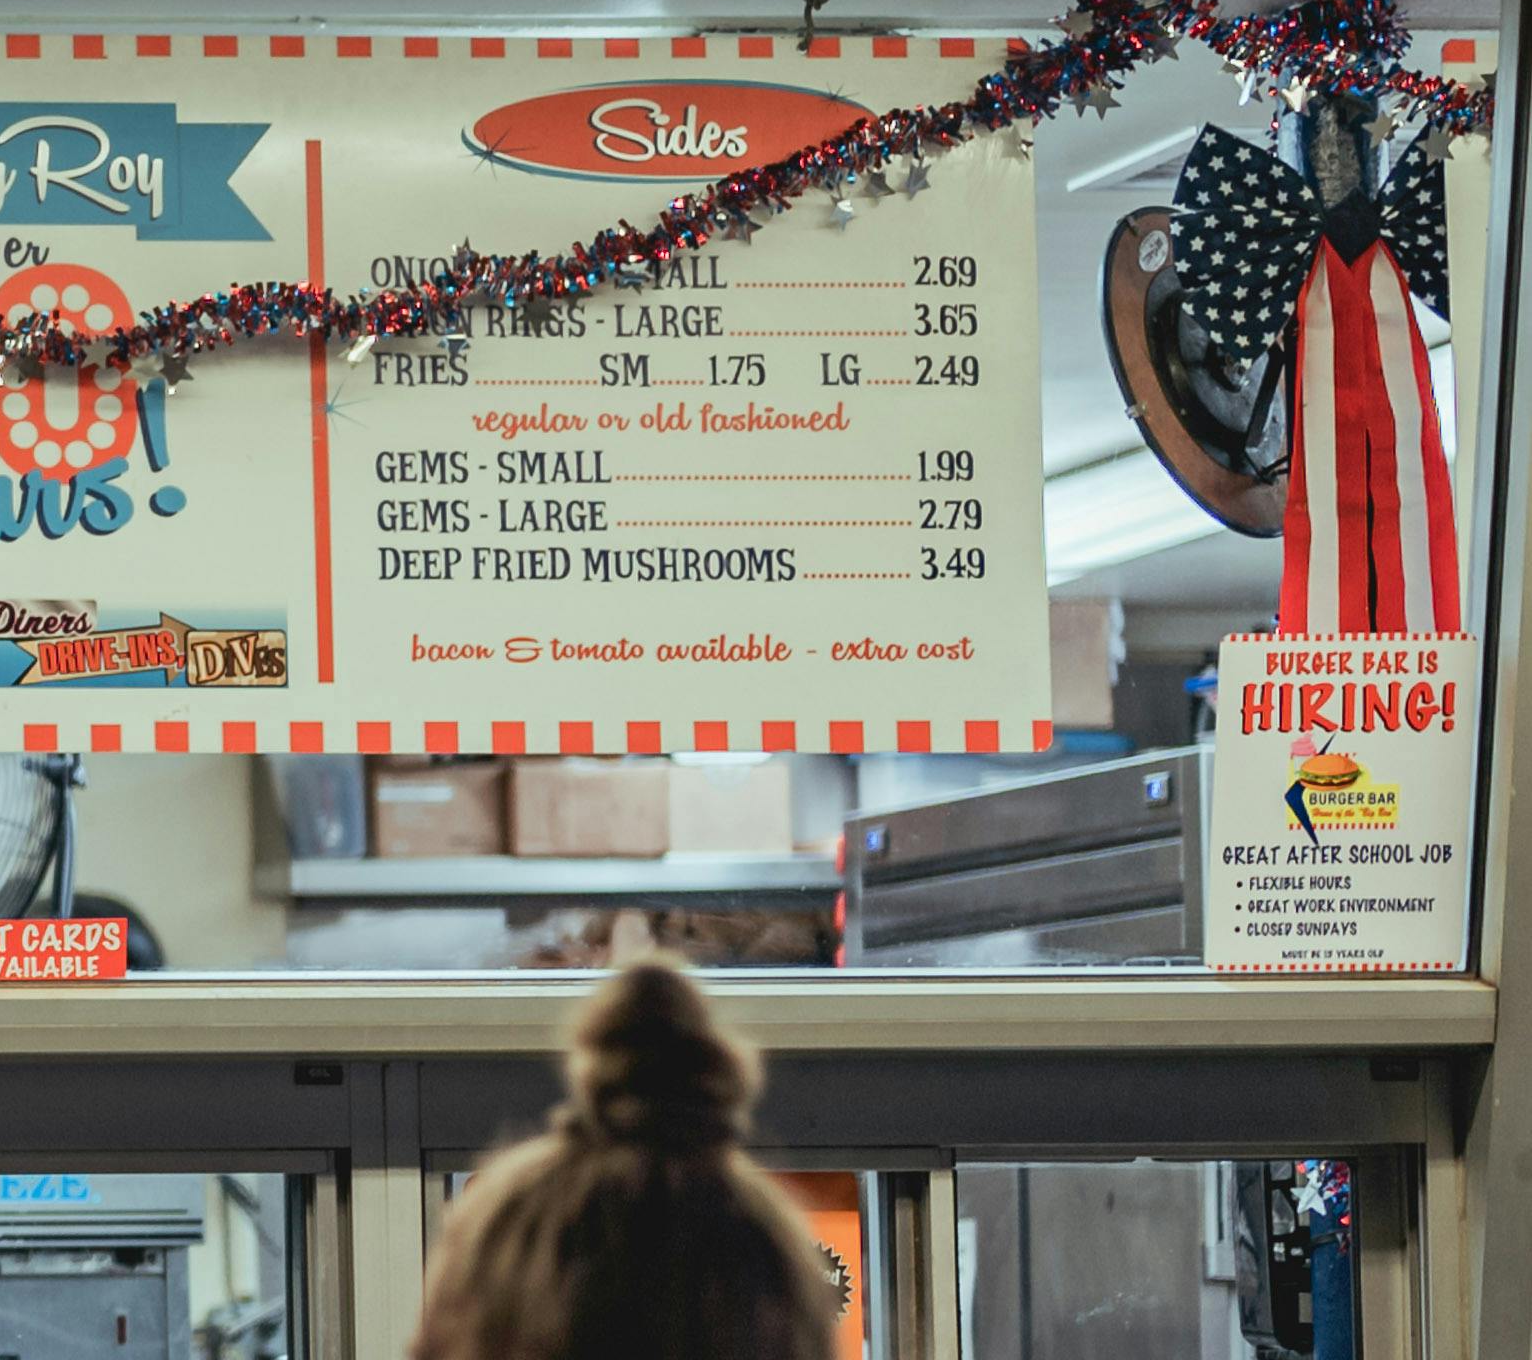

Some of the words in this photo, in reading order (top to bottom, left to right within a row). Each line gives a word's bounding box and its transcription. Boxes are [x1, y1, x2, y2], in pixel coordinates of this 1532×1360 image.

[587, 98, 748, 162] Sides
[913, 255, 977, 288] 2.69
[371, 351, 469, 387] FRIES
[599, 353, 651, 388] SM
[709, 353, 766, 387] 1.75
[820, 353, 862, 386] LG
[914, 355, 980, 387] 2.49
[471, 402, 589, 441] regular
[597, 412, 631, 432] or
[639, 401, 692, 434] old
[699, 400, 851, 434] fashioned
[378, 547, 462, 581] DEEP
[472, 546, 571, 582] FRIED
[582, 547, 796, 583] MUSHROOMS
[921, 546, 986, 581] 3.49
[38, 632, 186, 678] DRIVE-INS,
[411, 633, 495, 663] bacon
[549, 637, 645, 663] tomato
[656, 633, 792, 663] available
[831, 636, 909, 662] extra
[916, 636, 975, 661] cost
[1266, 651, 1354, 676] BURGER
[1362, 650, 1410, 675] BAR
[1417, 650, 1439, 675] IS
[1240, 681, 1456, 736] HIRING!
[1308, 791, 1365, 806] BURGER
[1367, 791, 1396, 805] BAR
[1222, 845, 1280, 865] GREAT
[1286, 844, 1343, 865] AFTER
[1348, 844, 1414, 865] SCHOOL
[1419, 843, 1453, 864] JOB
[1249, 876, 1305, 891] FLEXIBLE
[1309, 875, 1352, 890] HOURS
[1247, 899, 1290, 914] GREAT
[1293, 898, 1335, 914] WORK
[1339, 897, 1435, 913] ENVIRONMENT
[22, 922, 120, 952] CARDS
[1246, 922, 1293, 937] CLOSED
[1296, 921, 1358, 937] SUNDAYS
